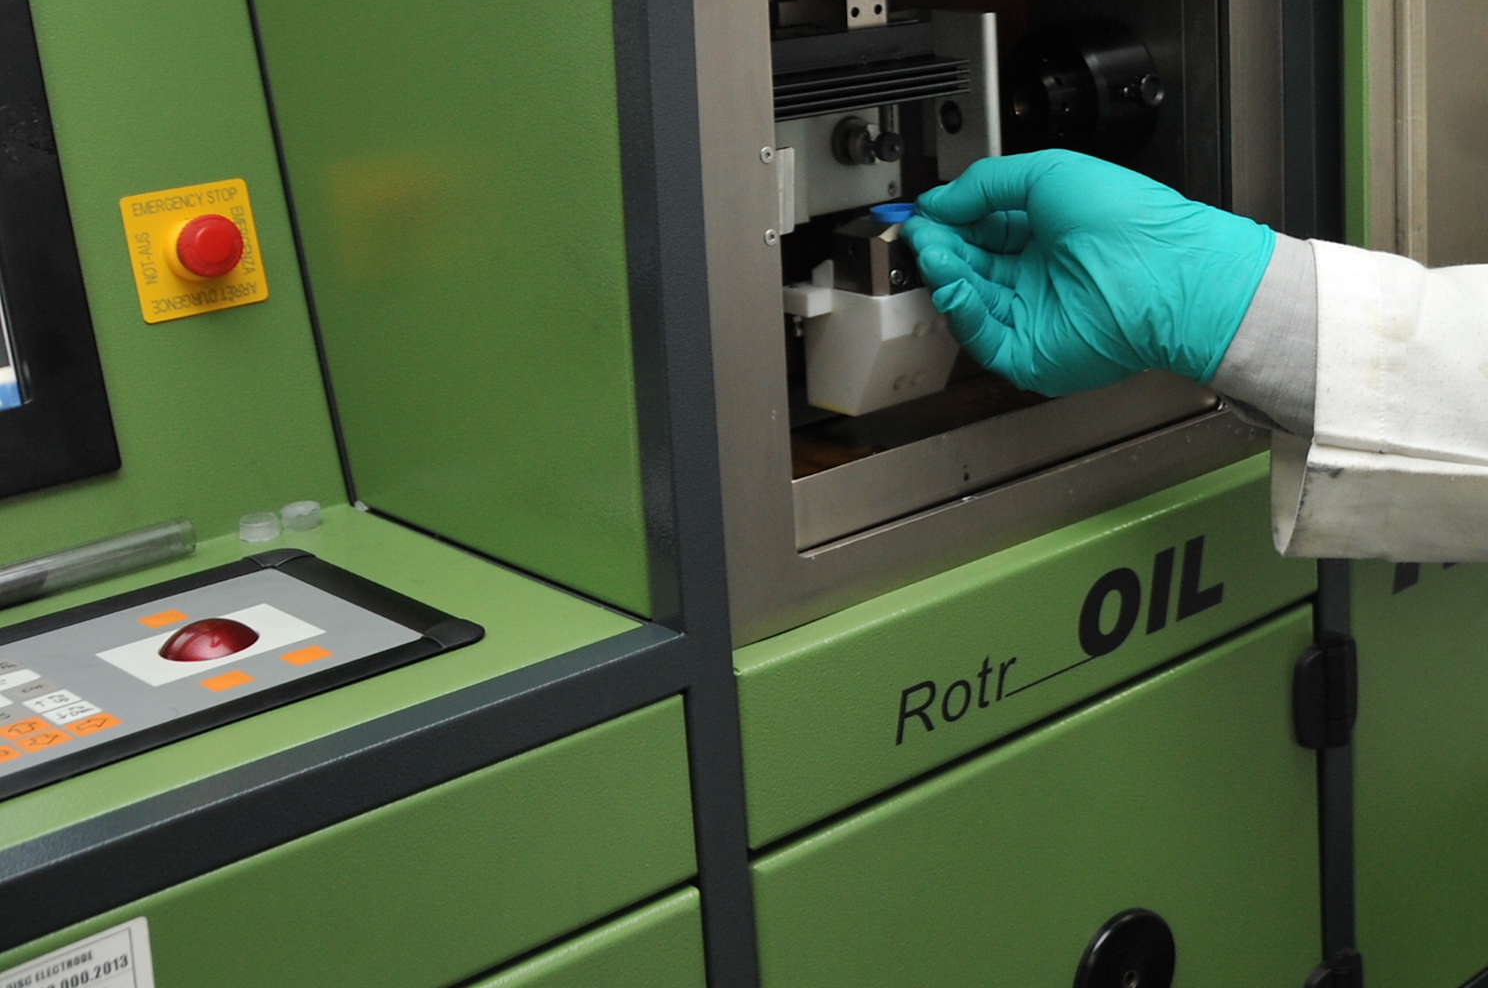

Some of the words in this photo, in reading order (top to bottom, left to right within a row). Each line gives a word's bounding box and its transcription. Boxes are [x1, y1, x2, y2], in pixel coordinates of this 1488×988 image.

[132, 192, 203, 217] EMERGENCY
[206, 187, 237, 204] STOP
[1078, 535, 1225, 658] OIL
[35, 950, 94, 982] ELECTRODE
